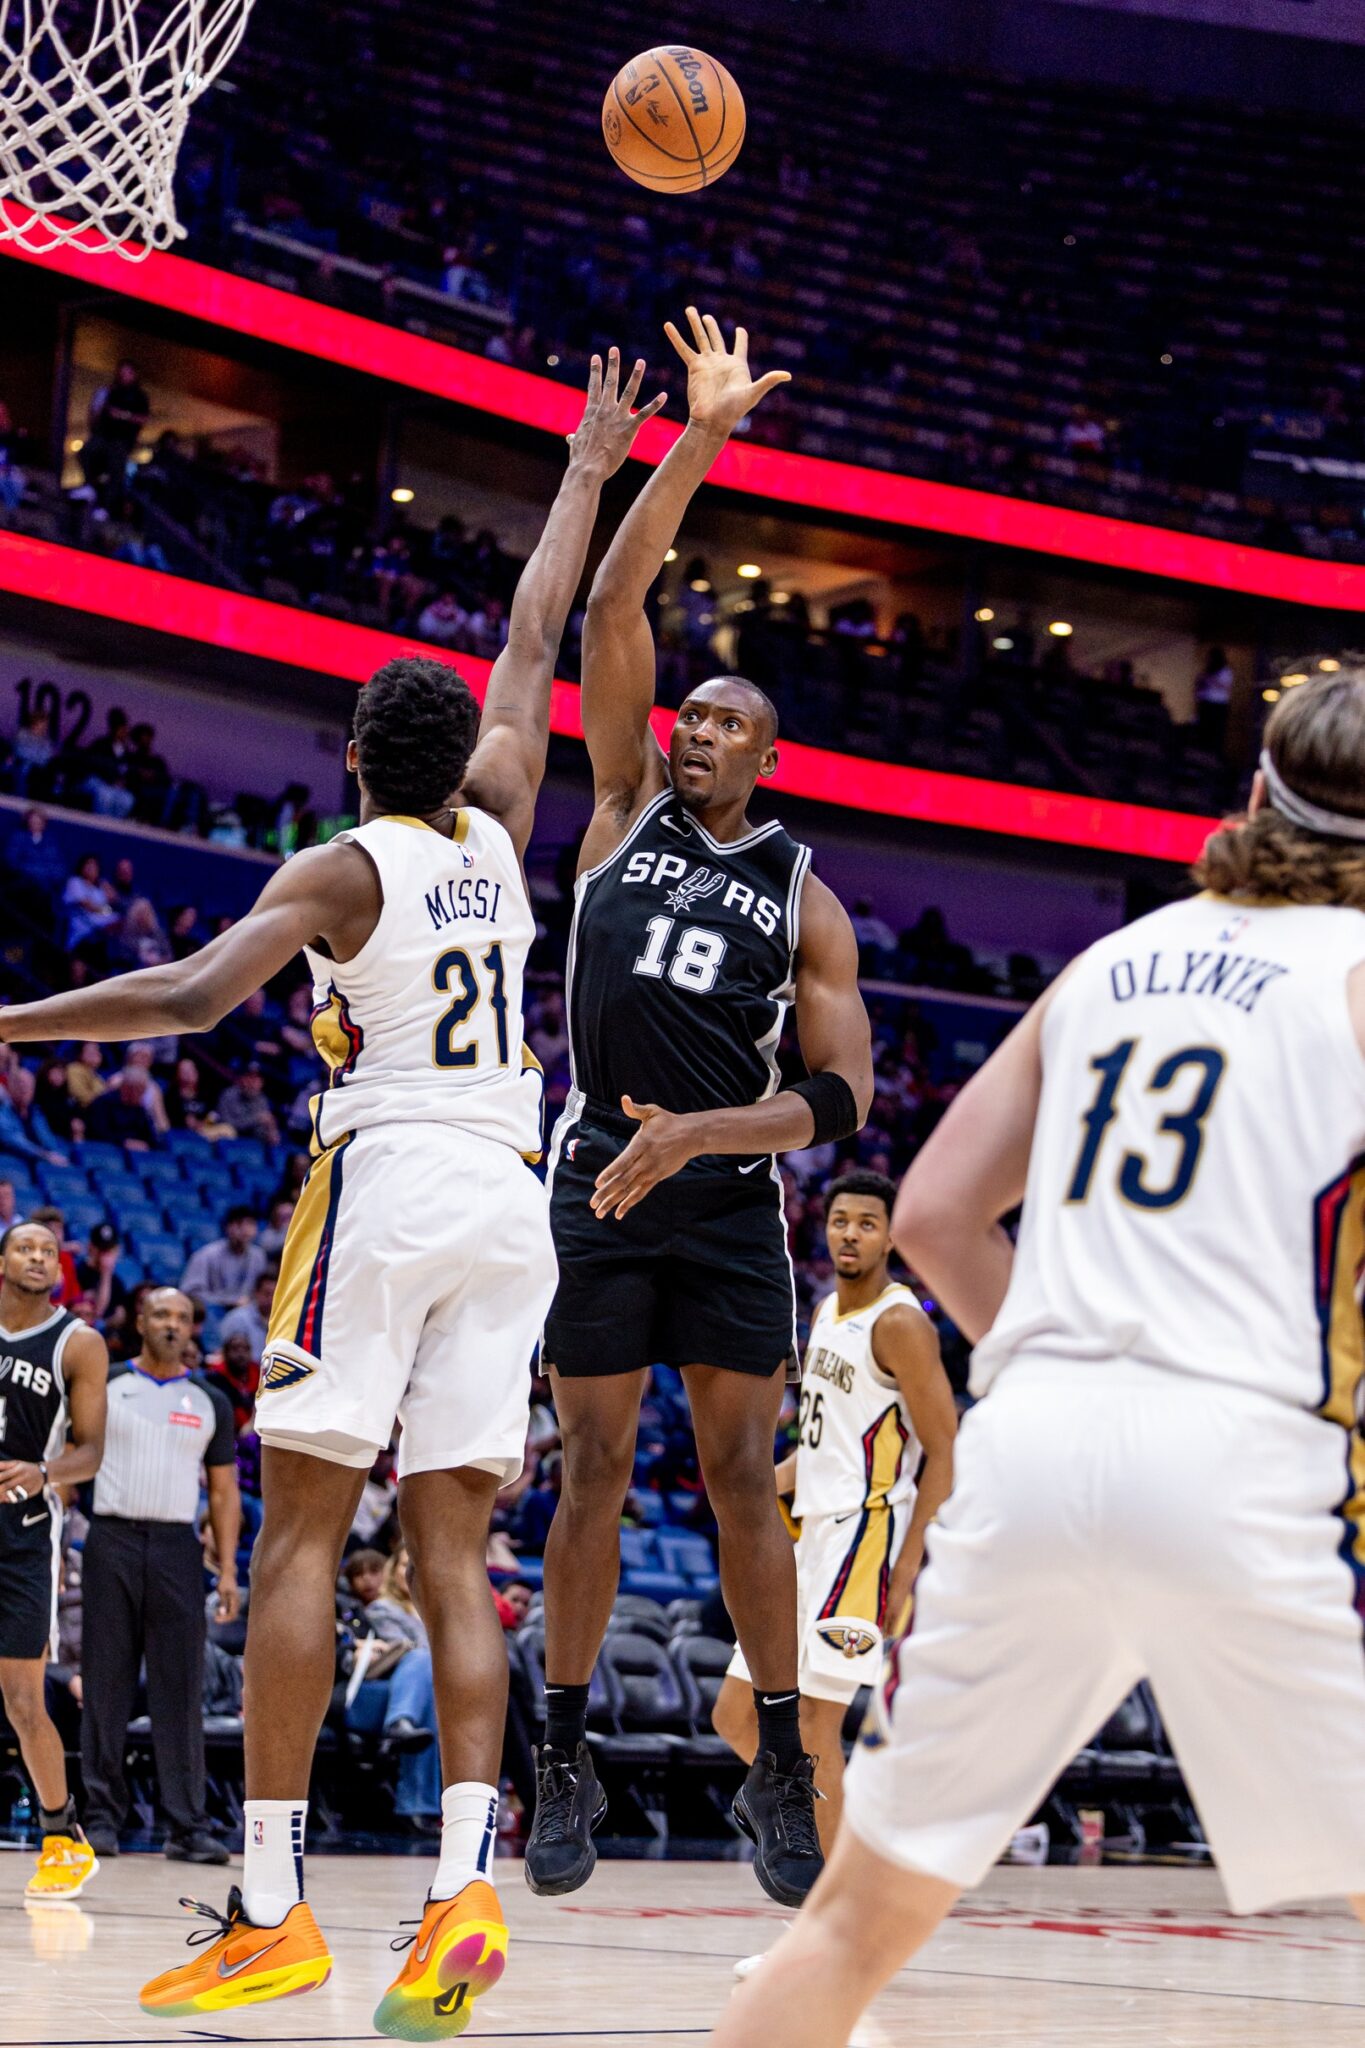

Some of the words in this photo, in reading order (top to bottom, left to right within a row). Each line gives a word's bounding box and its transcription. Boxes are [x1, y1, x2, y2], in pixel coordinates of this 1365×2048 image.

[16, 678, 93, 748] 102
[424, 879, 502, 931] MISSI
[632, 914, 727, 994] 18
[431, 940, 509, 1070] 21
[1062, 1035, 1228, 1213] 13
[799, 1389, 825, 1449] 25
